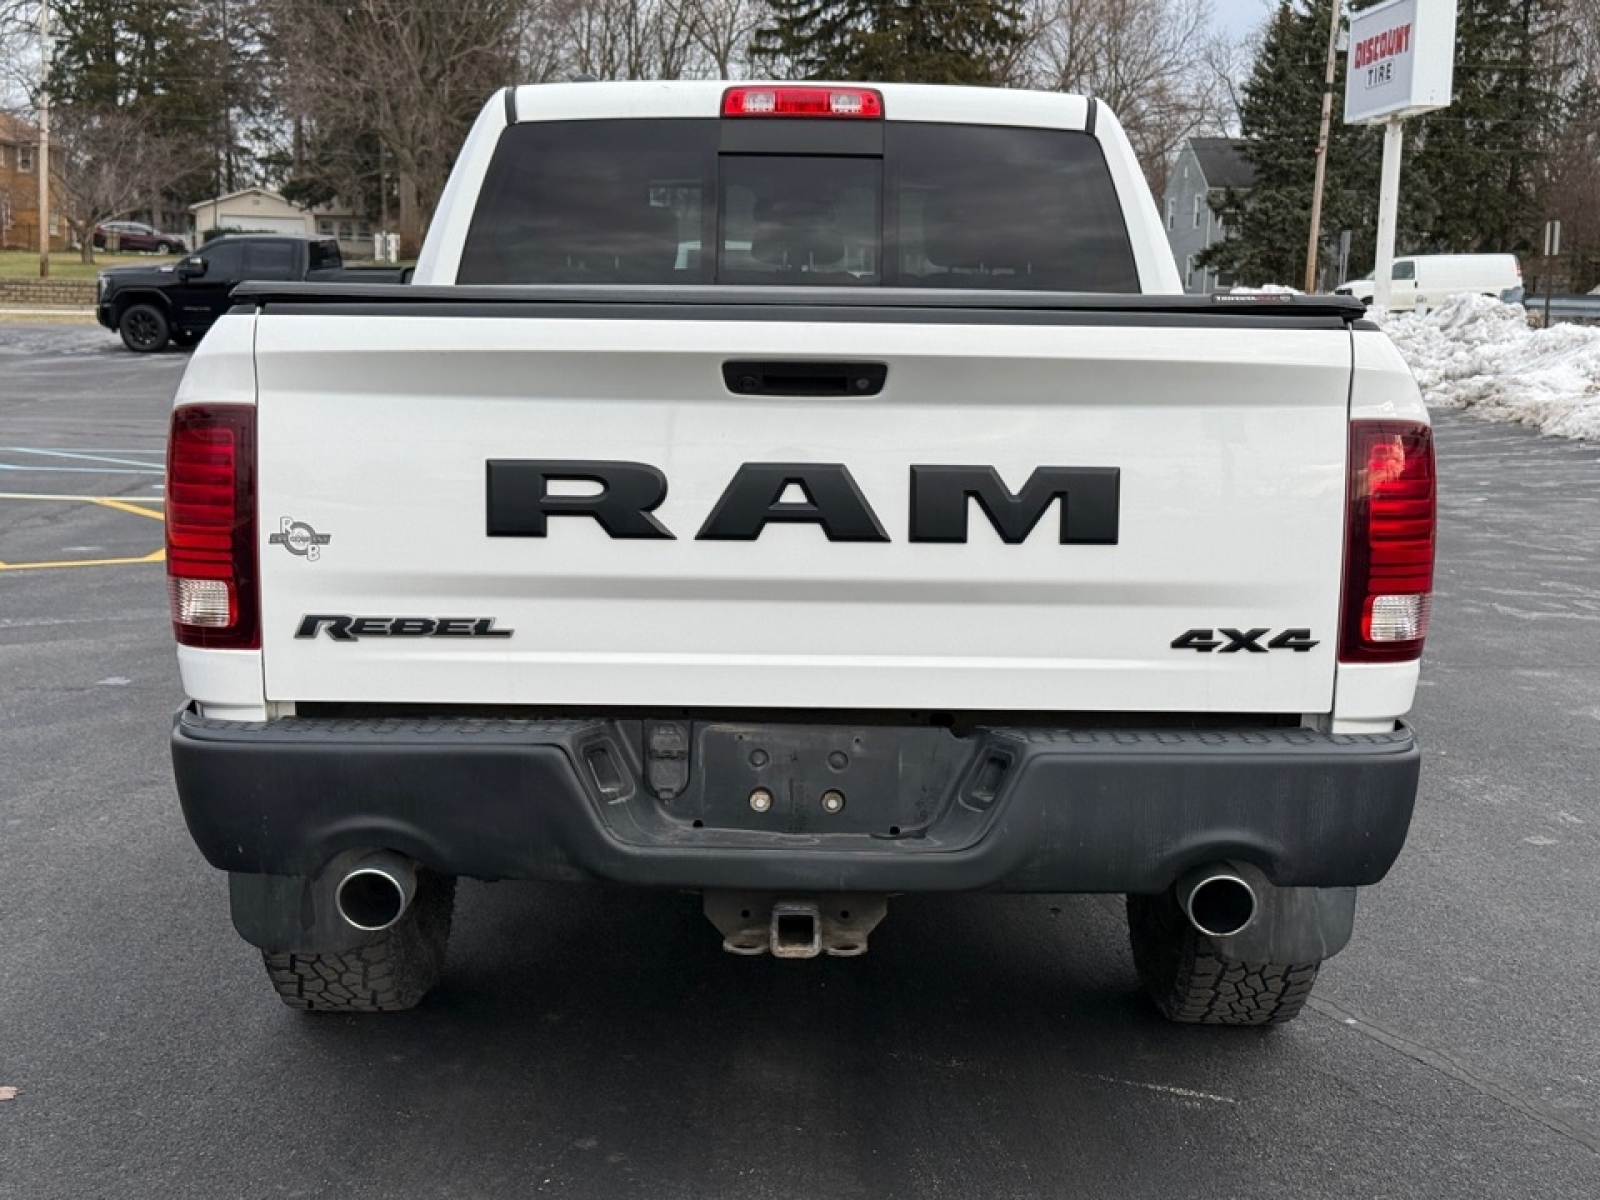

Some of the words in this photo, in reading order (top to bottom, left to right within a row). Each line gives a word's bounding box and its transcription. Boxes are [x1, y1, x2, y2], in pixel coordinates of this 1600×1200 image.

[1354, 23, 1411, 69] DISCOUNT
[1367, 62, 1392, 86] TIRE
[486, 459, 1120, 545] RAM
[294, 614, 515, 642] REBEL
